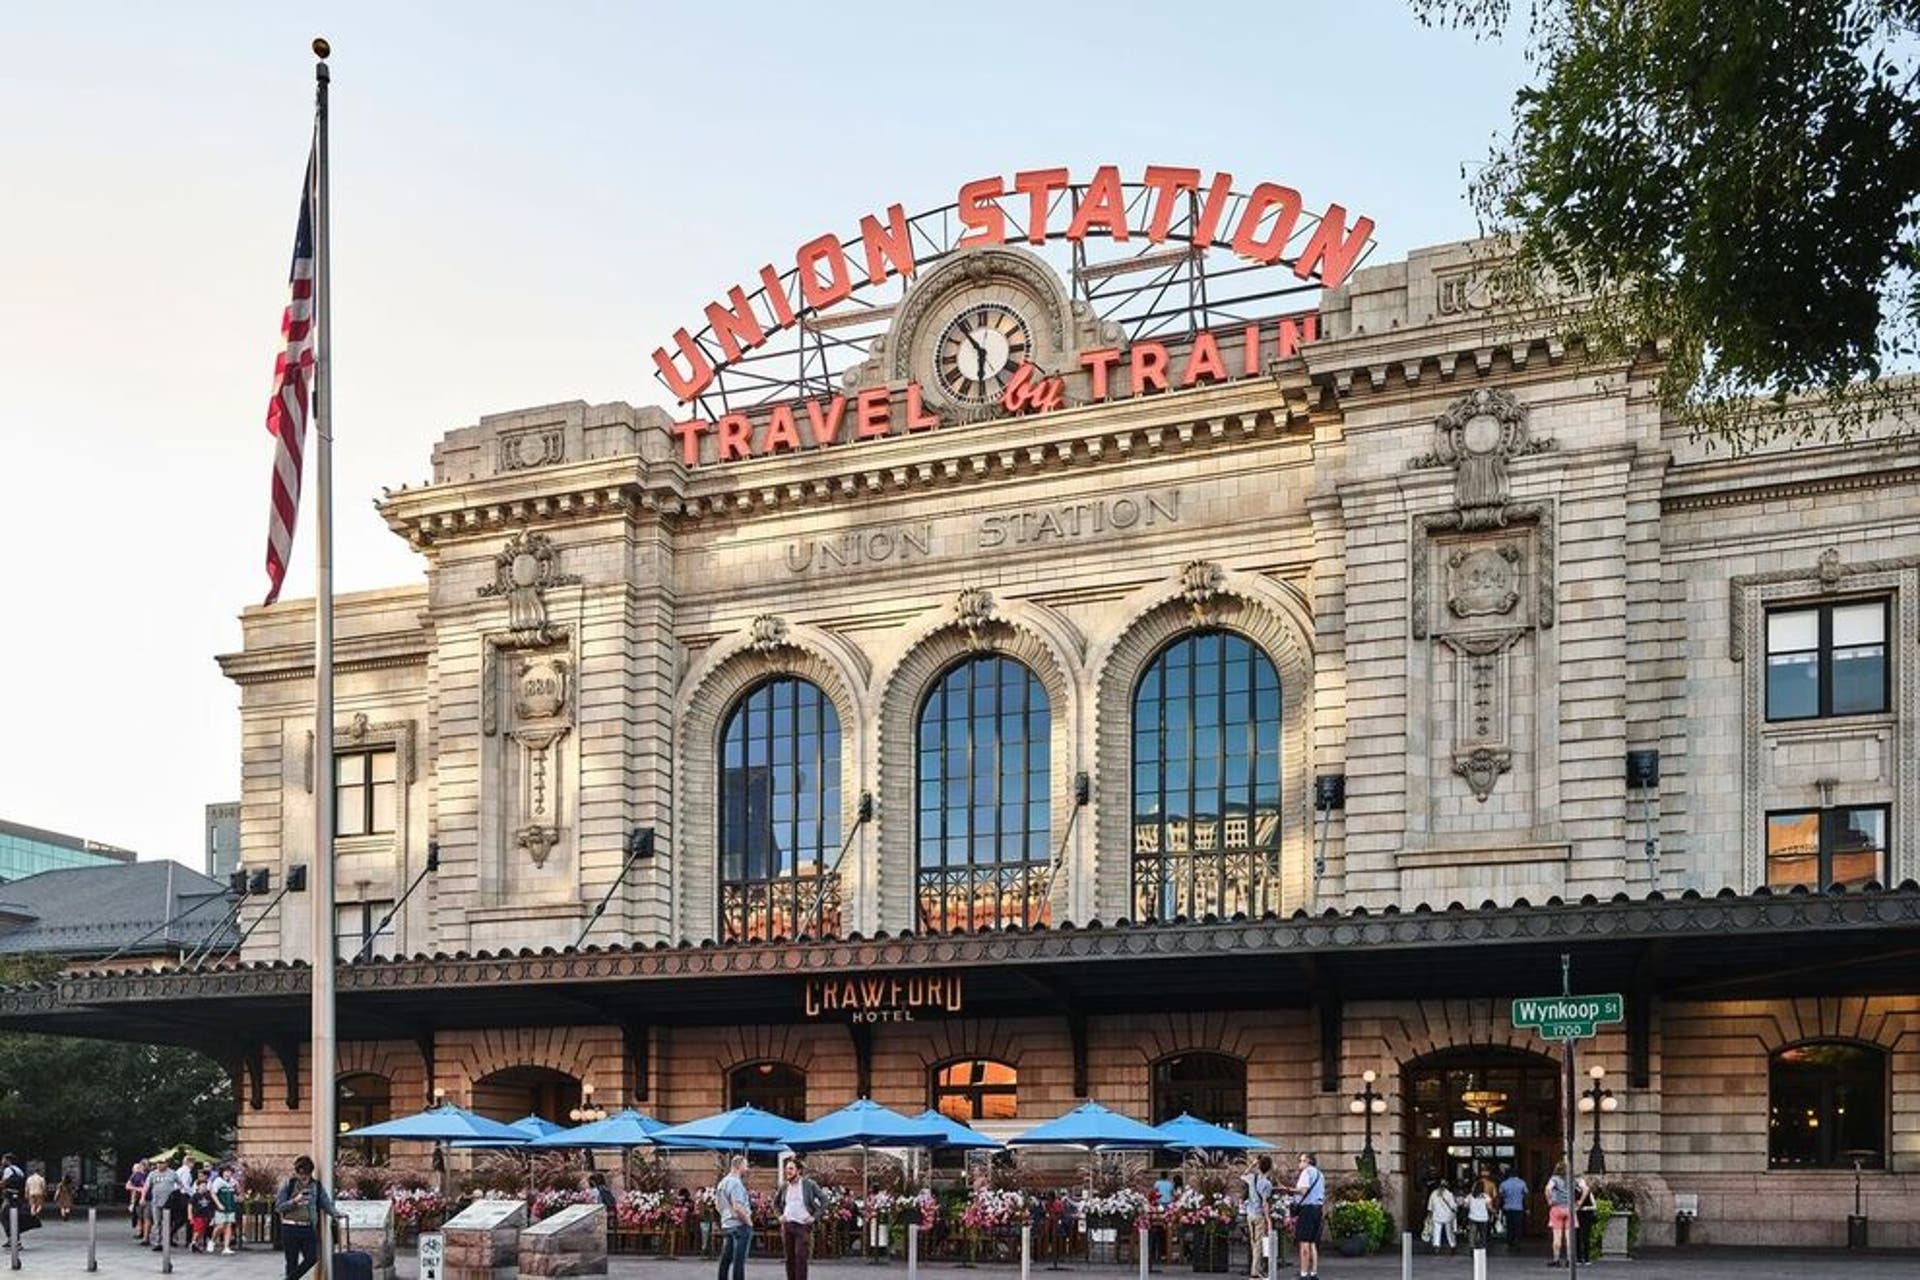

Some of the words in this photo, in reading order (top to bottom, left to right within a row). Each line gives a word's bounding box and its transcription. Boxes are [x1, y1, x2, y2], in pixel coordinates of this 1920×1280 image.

[651, 203, 914, 402] UNION
[958, 165, 1376, 288] STATION
[672, 382, 939, 467] TRAVEL
[1000, 360, 1065, 415] by
[1079, 312, 1317, 401] TRAIN
[785, 520, 932, 573] UNION
[978, 489, 1181, 548] STATION
[806, 975, 962, 1016] CRAWFORD
[852, 1009, 915, 1023] HOTEL
[1519, 1001, 1599, 1022] Wynkoop
[1604, 1002, 1617, 1014] St
[1553, 1024, 1582, 1036] 1700
